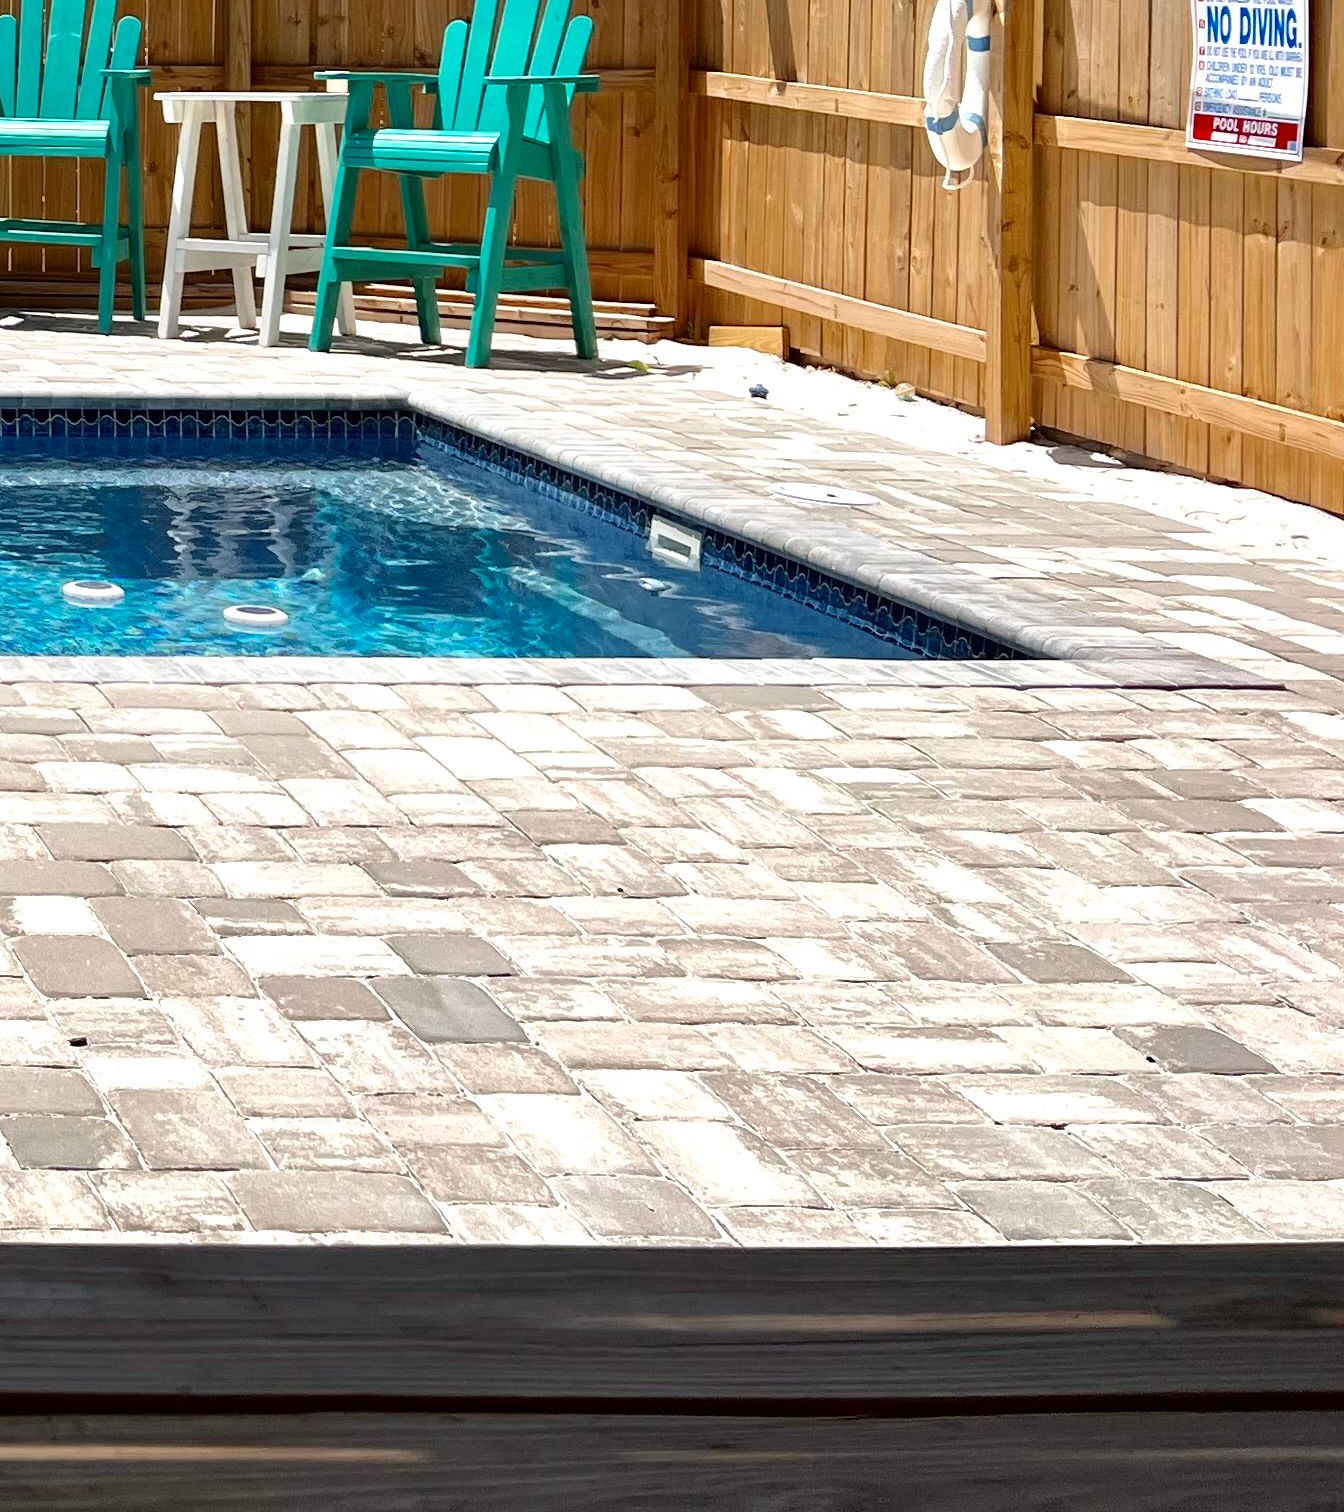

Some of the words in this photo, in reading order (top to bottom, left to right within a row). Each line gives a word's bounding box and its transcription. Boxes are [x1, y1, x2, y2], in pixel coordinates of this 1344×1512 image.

[1207, 6, 1231, 44] NO
[1239, 7, 1302, 48] DIVING.
[1213, 117, 1239, 132] POOL
[1242, 120, 1279, 136] HOURS
